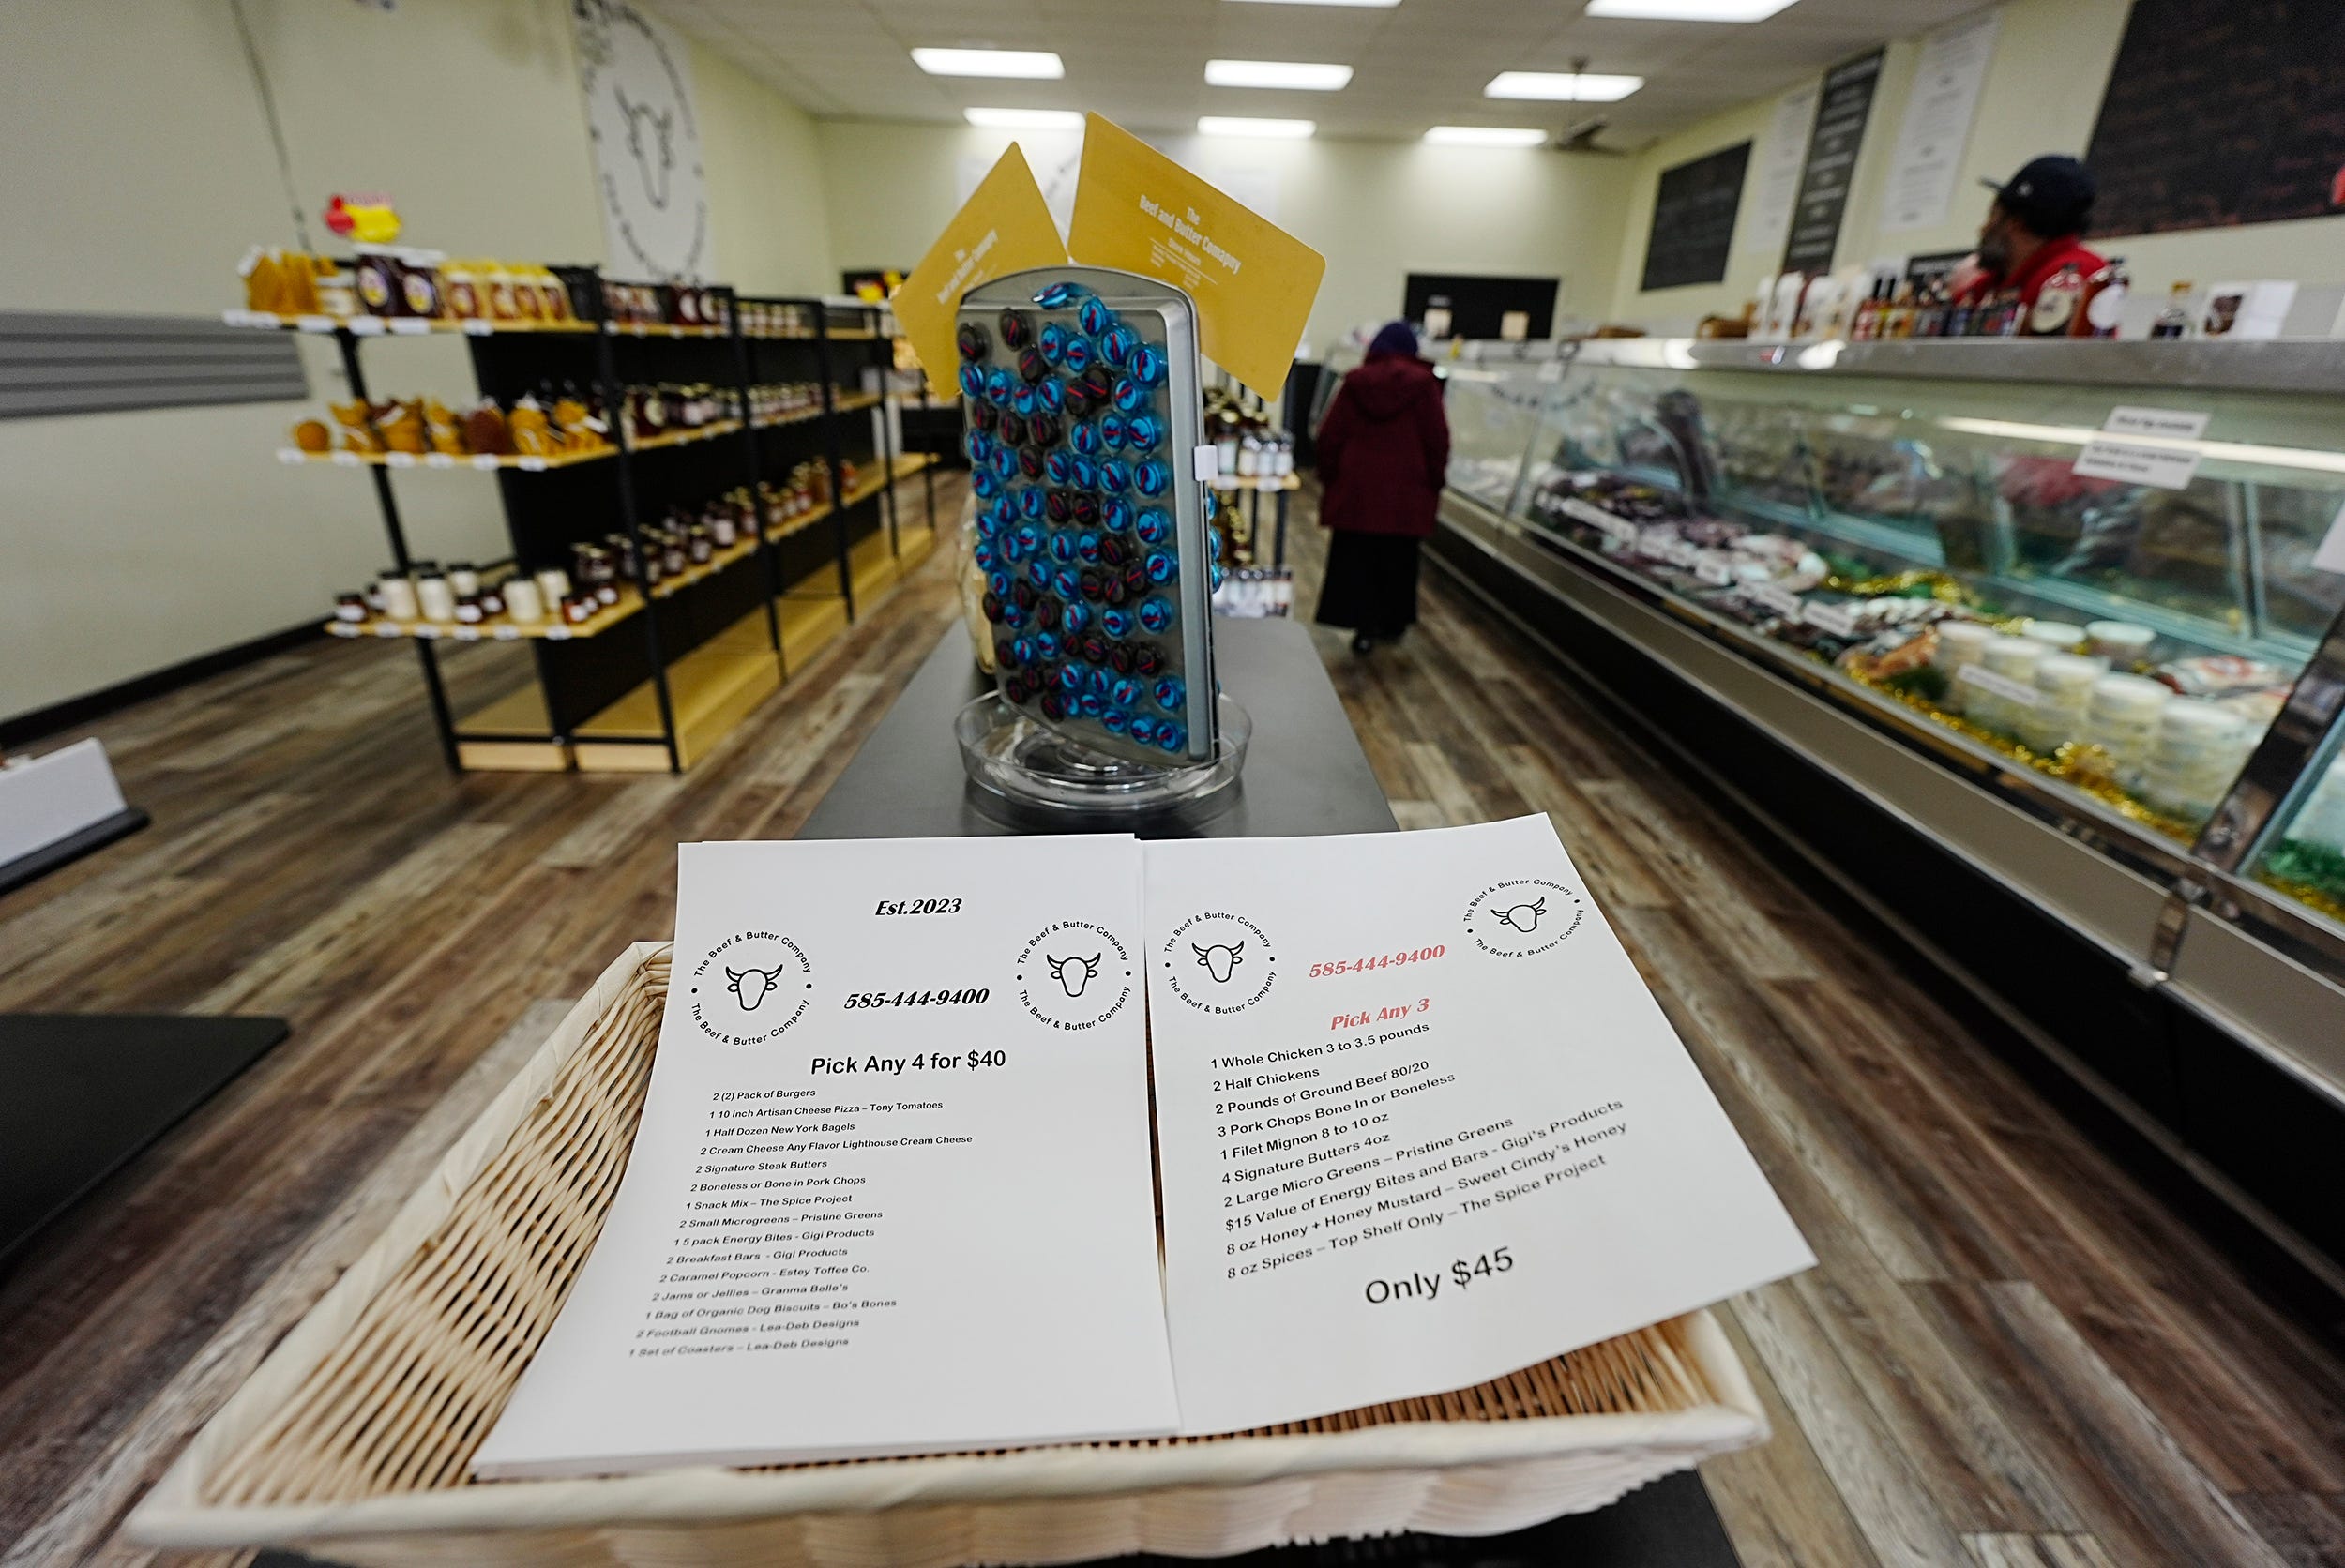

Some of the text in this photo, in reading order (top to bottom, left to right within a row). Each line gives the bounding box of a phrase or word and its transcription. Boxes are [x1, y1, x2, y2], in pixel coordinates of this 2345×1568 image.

[1140, 194, 1159, 217] Beef
[1158, 209, 1175, 228] and
[1174, 218, 1203, 246] Butter
[874, 897, 962, 916] Est.2023
[1464, 909, 1474, 921] The
[1470, 891, 1488, 907] Beef
[1498, 880, 1529, 888] Butter
[1534, 879, 1573, 896] Company
[694, 959, 709, 976] The
[708, 939, 732, 957] Beef
[747, 931, 779, 941] Butter
[781, 937, 810, 972] Company
[1475, 939, 1488, 950] The
[1490, 948, 1513, 957] Beef
[1527, 940, 1558, 956] Butter
[1560, 910, 1584, 940] Company
[1309, 944, 1445, 978] 585-444-9400
[843, 988, 991, 1010] 585-444-9400
[1330, 998, 1430, 1031] Pick Any 3
[691, 1003, 702, 1020] The
[700, 1021, 721, 1039] Beef
[734, 1035, 766, 1045] Butter
[771, 1000, 809, 1037] Company
[810, 1048, 1006, 1076] Pick Any 4 for $40
[1210, 1024, 1430, 1069] 1 Whole Chicken 3 to 3.5 pounds
[712, 1090, 816, 1103] 2 (2) Pack of Burgers
[1215, 1060, 1430, 1115] 2 Pounds of Ground Beef 80/20
[1218, 1074, 1456, 1138] 3 Pork Chops Bone In or Boneless
[709, 1101, 944, 1119] 1 10 inch Artisan Cheese Pizza Tony Tomatoes
[700, 1136, 973, 1155] 2 Cream Cheese Any Flavor Lighthouse Cream Cheese
[1221, 1134, 1390, 1184] 4 Signature Butters 4oz
[1223, 1118, 1514, 1208] 2 Large Micro Greens Pristine Greens
[1225, 1101, 1624, 1232] $15 Value of Energy Bites and Bars Gigi's Products
[690, 1184, 698, 1193] 2
[699, 1182, 749, 1192] Boneless
[764, 1180, 792, 1189] Bone
[794, 1178, 804, 1187] in
[806, 1177, 831, 1186] Pork
[833, 1176, 866, 1186] Chops
[1226, 1123, 1626, 1255] 8 oz Honey + Honey Mustard Sweet Cindy's Honey
[674, 1229, 875, 1247] 1 5 pack Energy Bites Gigi Products
[679, 1212, 884, 1229] 2 Small Microgreens Pristine Greens
[1227, 1155, 1606, 1279] 8 oz Spices Top Shelf Only The Spice Project
[658, 1264, 870, 1283] 2 Caramel Popcorn Estey Toffee Co.
[1365, 1245, 1514, 1304] Only $45
[645, 1300, 897, 1320] 1 Bag of Organic Dog Biscuits Bo's Bones
